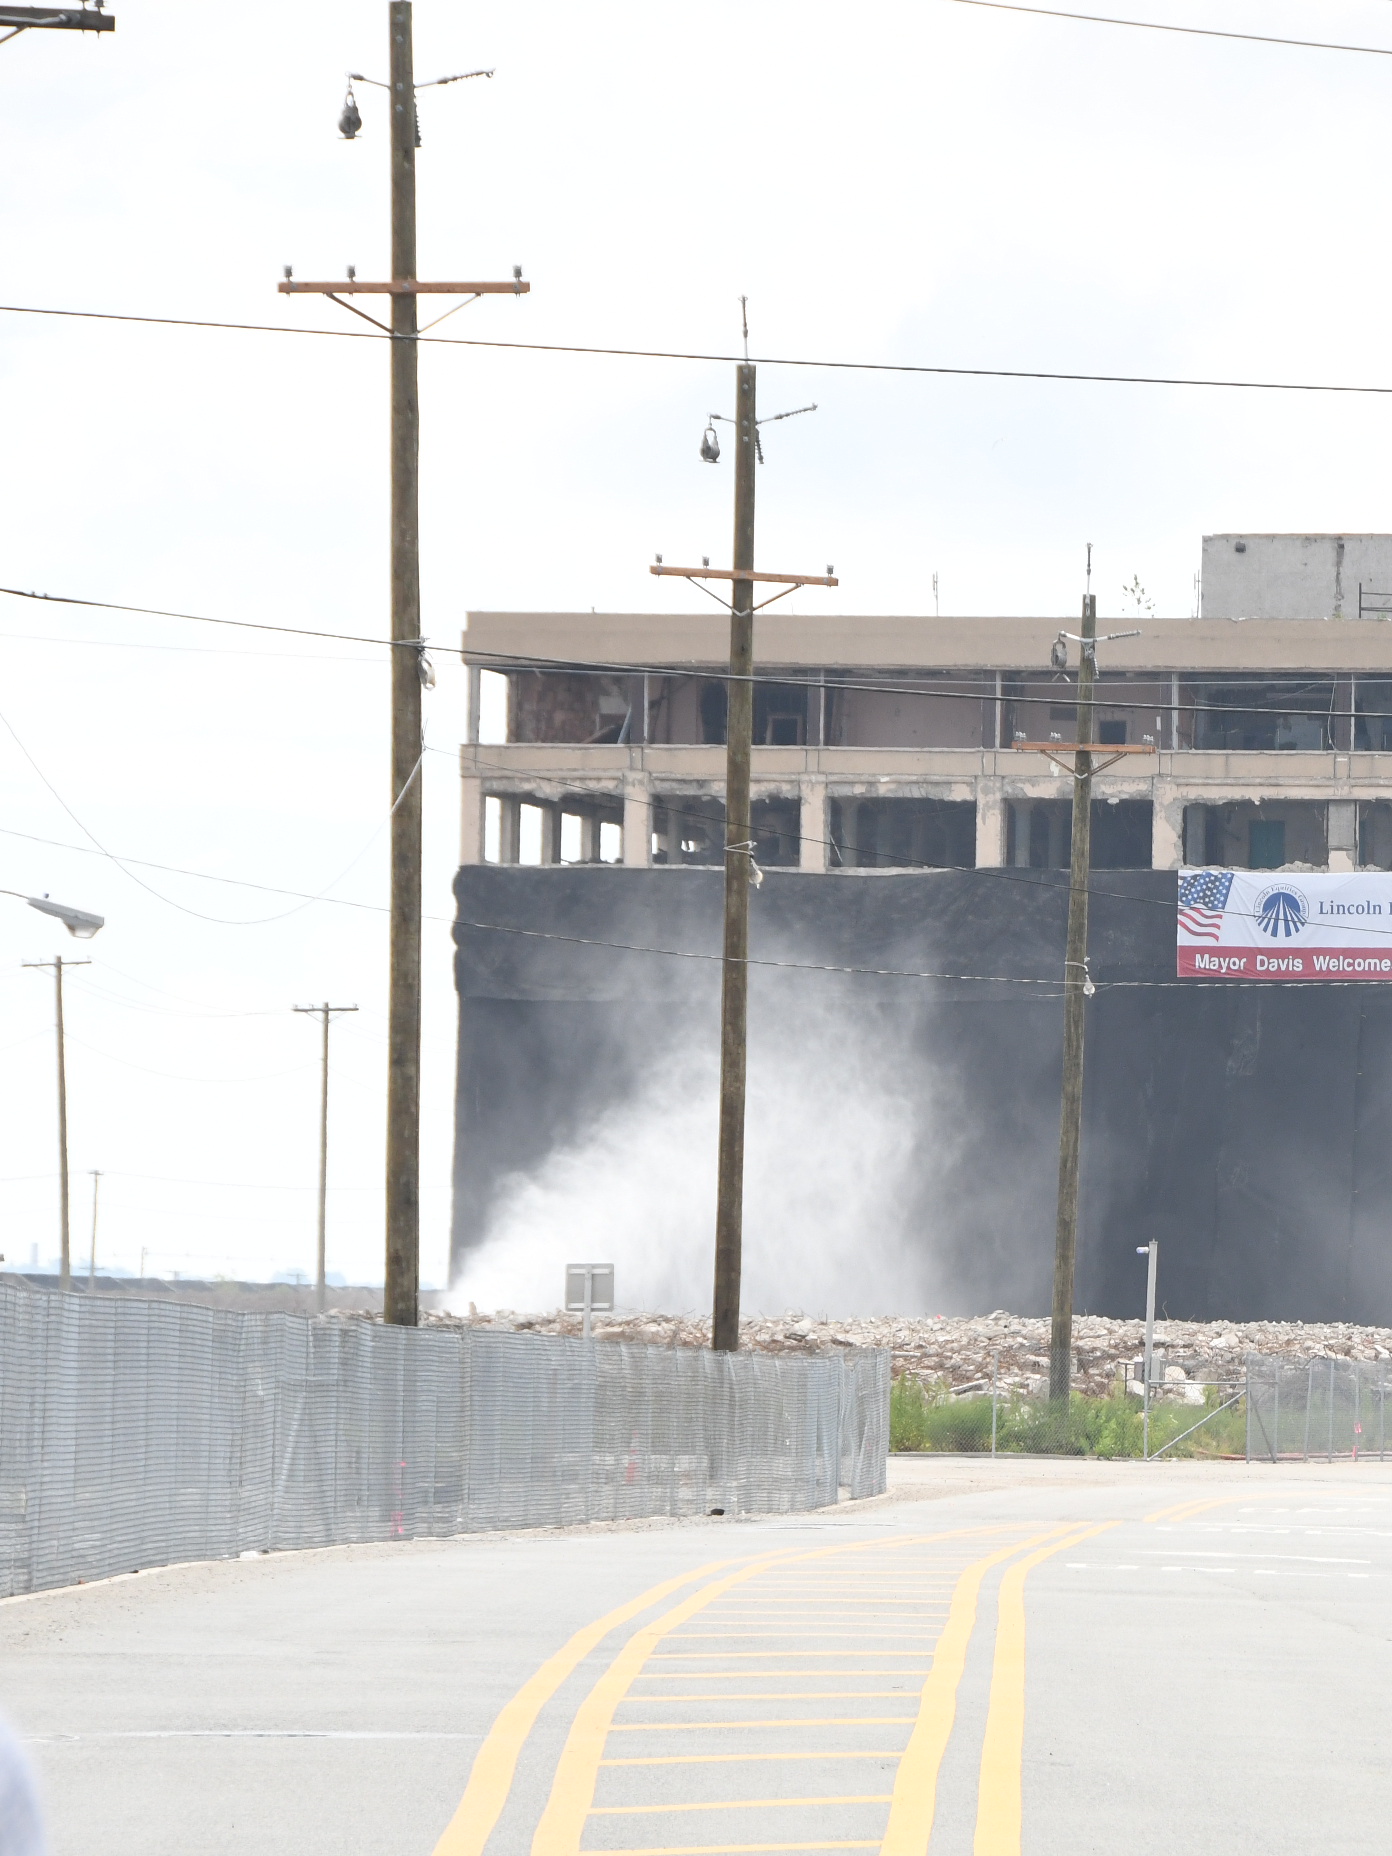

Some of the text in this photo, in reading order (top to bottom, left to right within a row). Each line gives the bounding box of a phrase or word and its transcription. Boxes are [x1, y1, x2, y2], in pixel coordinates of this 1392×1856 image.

[1318, 900, 1382, 915] Lincoln
[1195, 953, 1246, 973] Mayor
[1256, 955, 1303, 971] Davis
